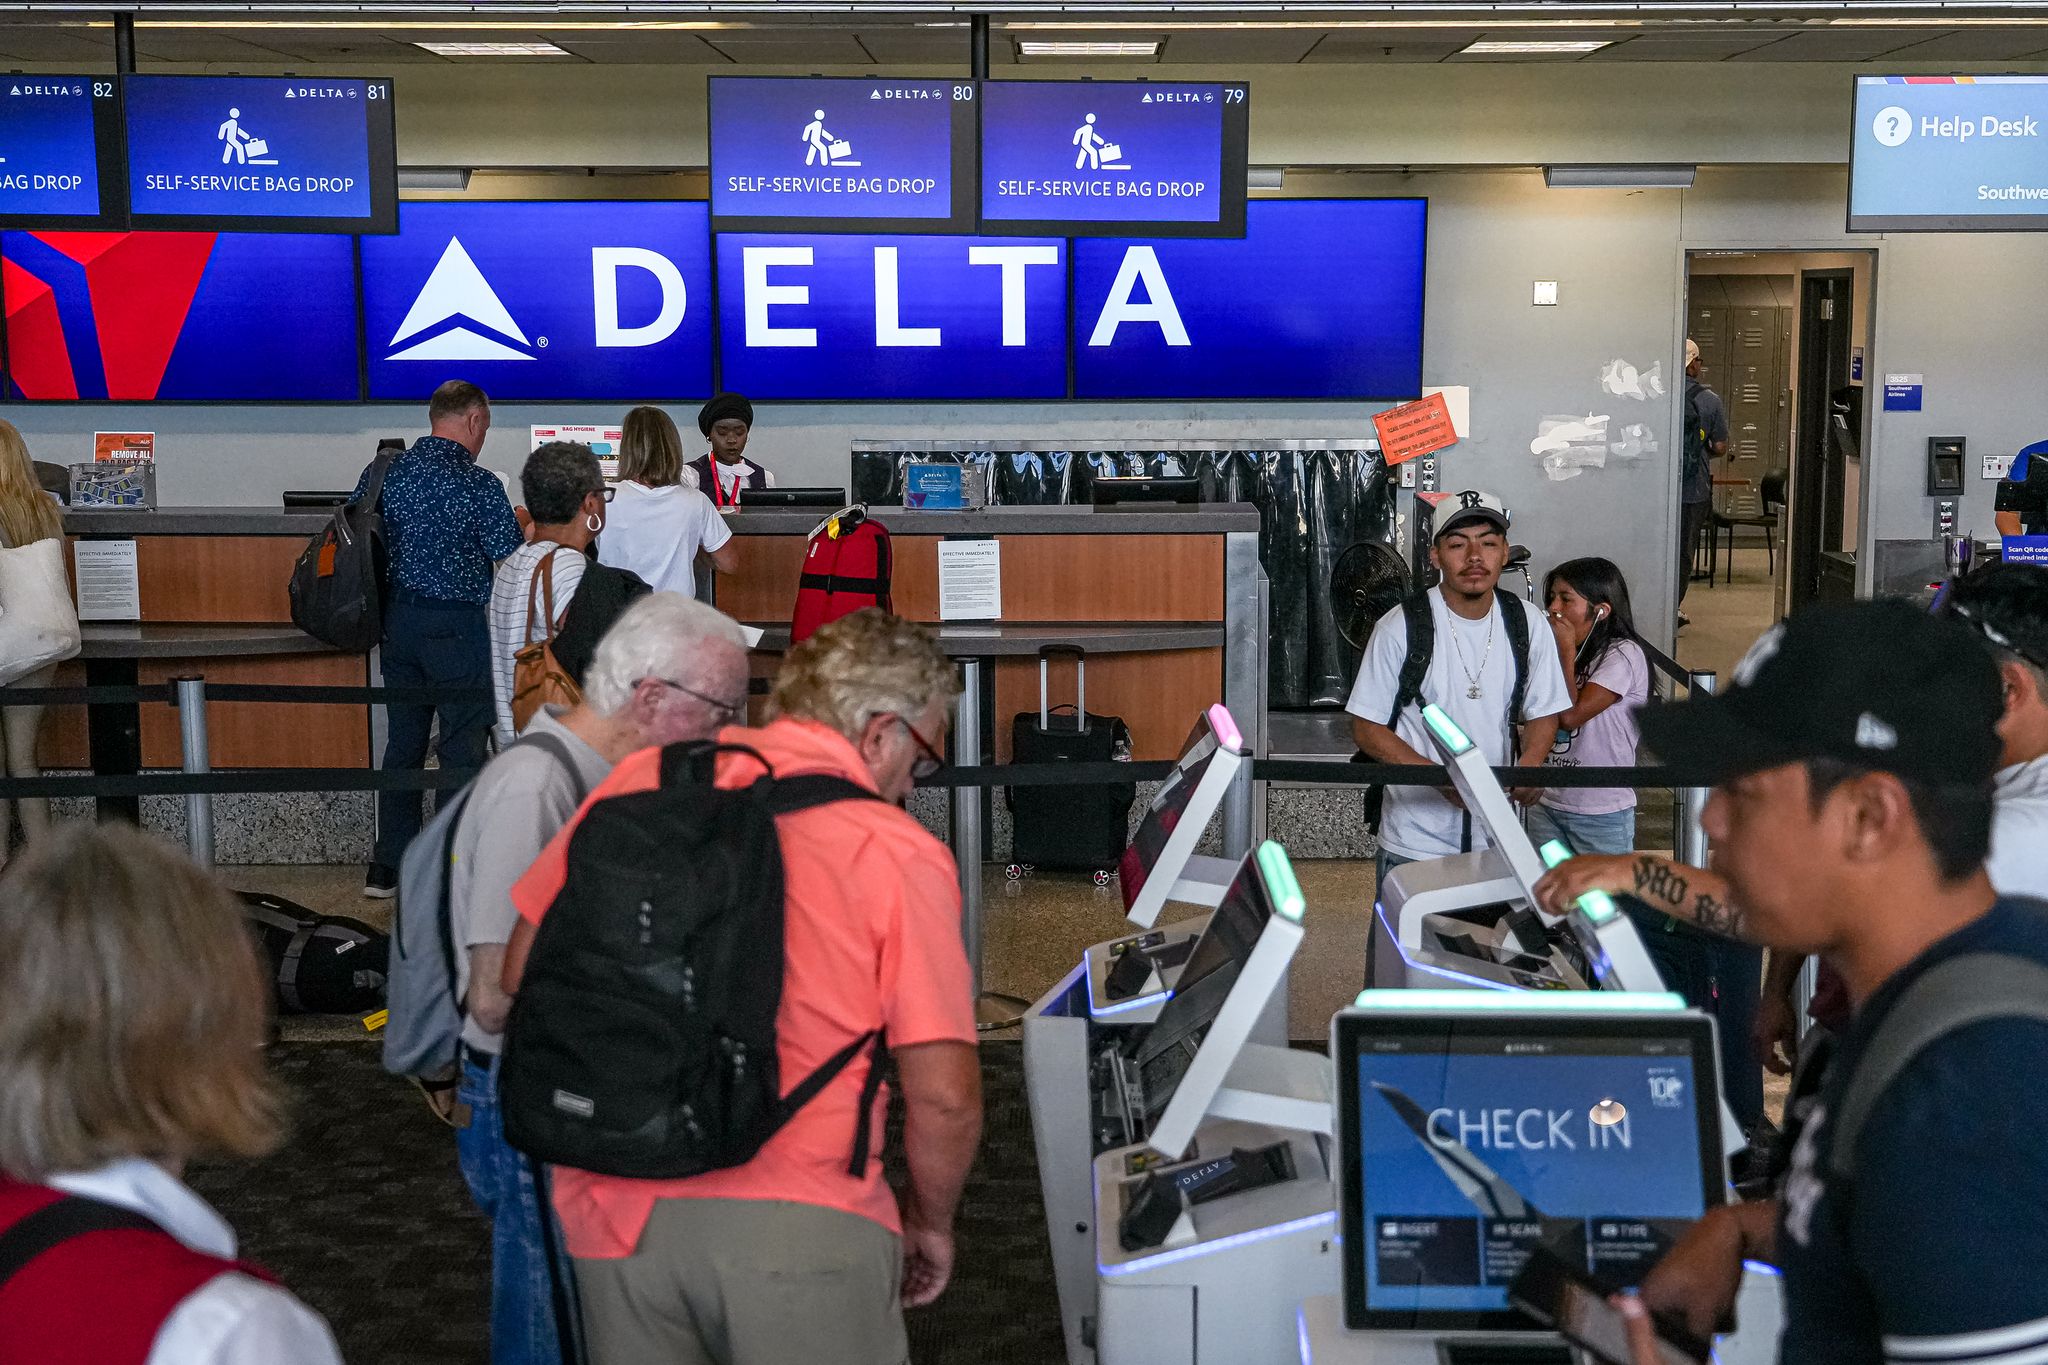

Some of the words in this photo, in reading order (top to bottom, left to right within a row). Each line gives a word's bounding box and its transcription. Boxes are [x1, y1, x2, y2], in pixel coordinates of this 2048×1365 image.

[25, 86, 69, 96] DELTA
[93, 83, 113, 97] 82
[300, 88, 343, 98] DELTA
[367, 85, 386, 100] 81
[885, 89, 929, 99] DELTA
[953, 86, 972, 101] 80
[1224, 89, 1244, 104] 79
[1156, 93, 1200, 103] DELTA
[1921, 115, 1975, 142] Help
[1981, 115, 2038, 137] Desk
[0, 175, 28, 190] AG
[33, 175, 82, 190] DROP
[146, 175, 260, 191] SELF-SERVICE
[265, 177, 301, 192] BAG
[306, 177, 354, 193] DROP
[728, 176, 842, 192] SELF-SERVICE
[847, 178, 883, 193] BAG
[888, 178, 936, 194] DROP
[998, 180, 1112, 196] SELF-SERVICE
[1117, 181, 1152, 197] BAG
[1157, 181, 1205, 198] DROP
[591, 245, 1192, 348] DELTA
[111, 450, 138, 458] REMOVE
[140, 450, 151, 458] ALL
[1427, 1107, 1576, 1150] CHECK
[1588, 1107, 1632, 1150] IN
[1510, 1223, 1542, 1237] SCAN
[1621, 1224, 1648, 1237] TYPE
